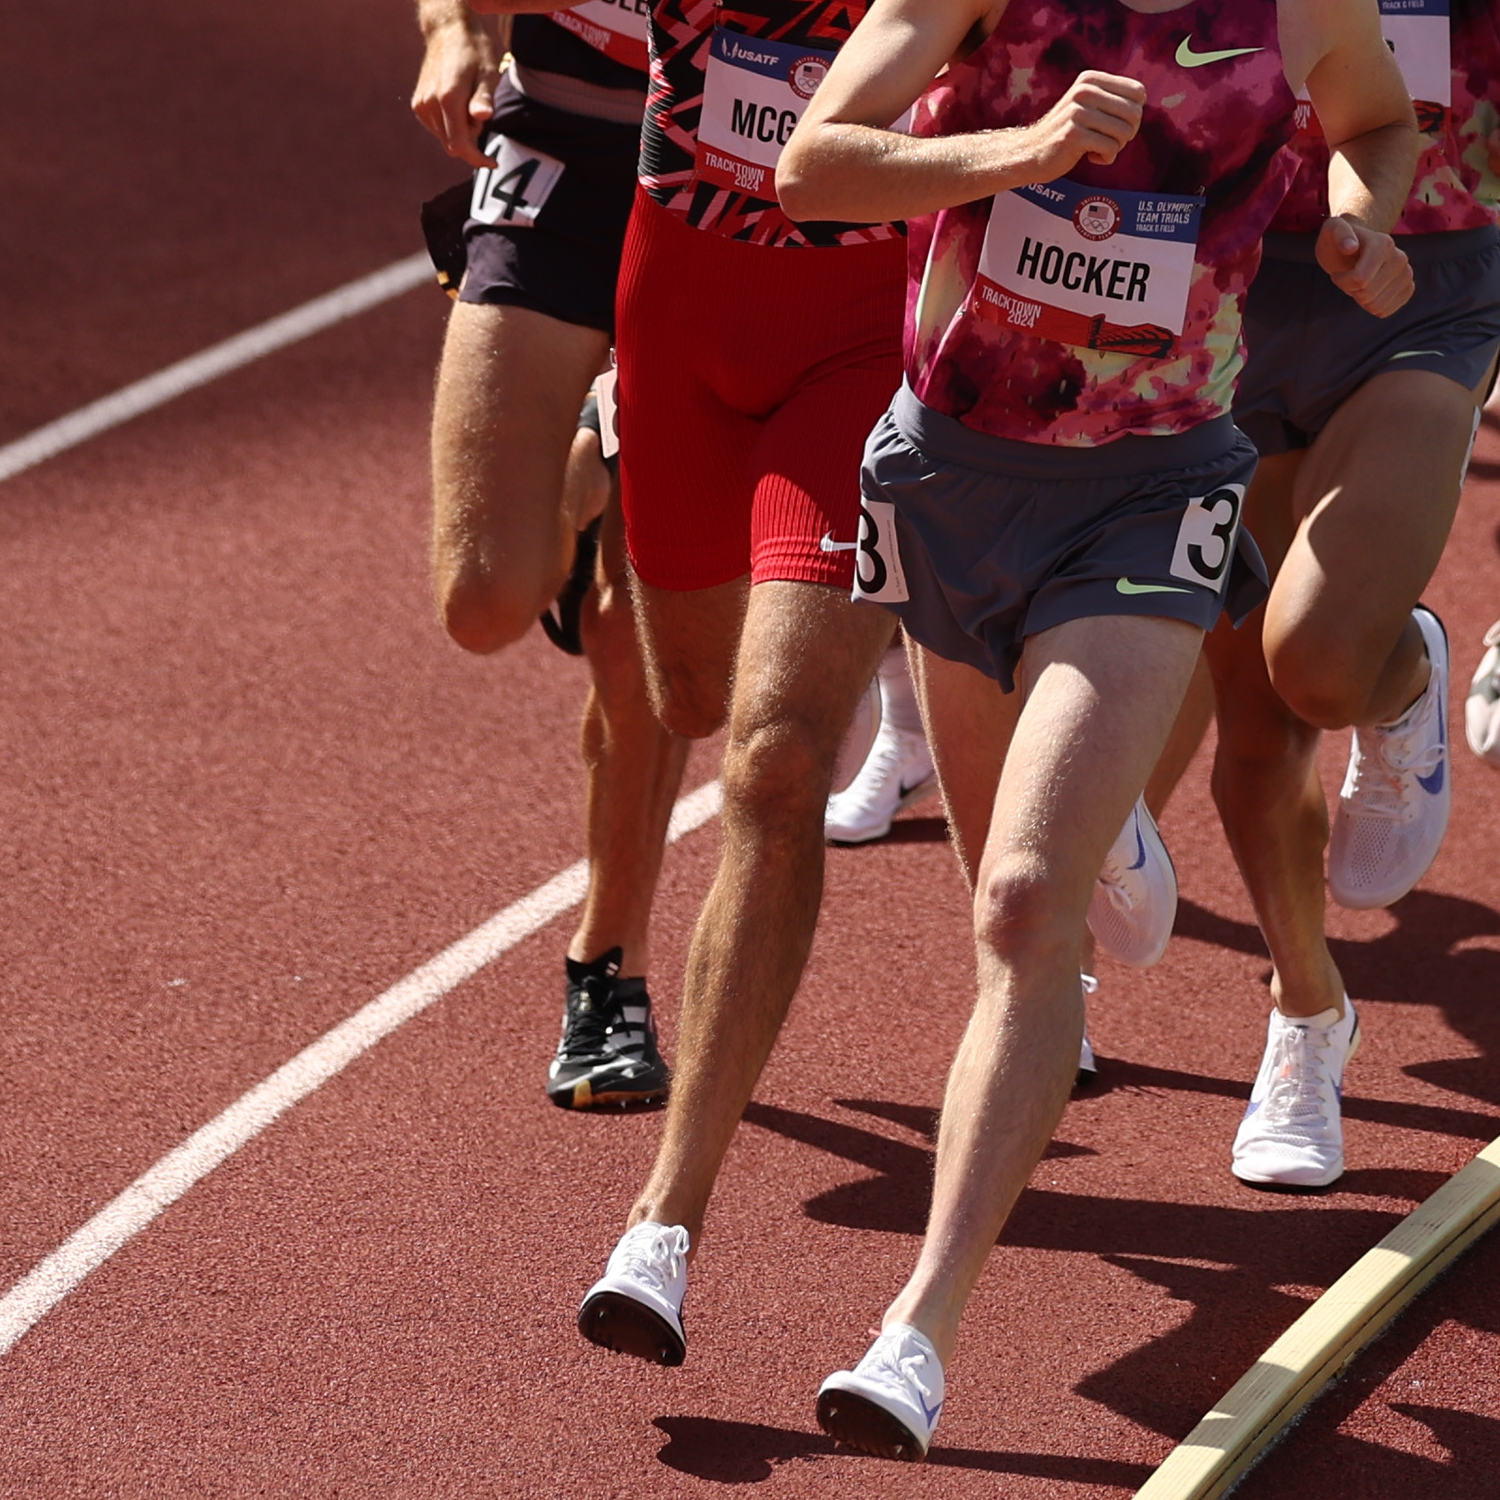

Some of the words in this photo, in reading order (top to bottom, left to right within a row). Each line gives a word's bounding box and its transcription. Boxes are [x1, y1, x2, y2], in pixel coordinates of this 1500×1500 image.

[738, 49, 780, 66] USATF
[478, 143, 541, 222] 14
[734, 173, 760, 192] 2024
[1136, 212, 1159, 223] TEAM
[1161, 212, 1190, 225] TRIALS
[1138, 200, 1154, 211] U.S.
[1157, 201, 1193, 213] OLYMPIC
[1016, 236, 1150, 302] HOCKER
[982, 285, 1041, 318] TRACKTOWN
[1007, 309, 1035, 328] 2024
[1187, 488, 1241, 581] 3
[856, 504, 887, 594] 3
